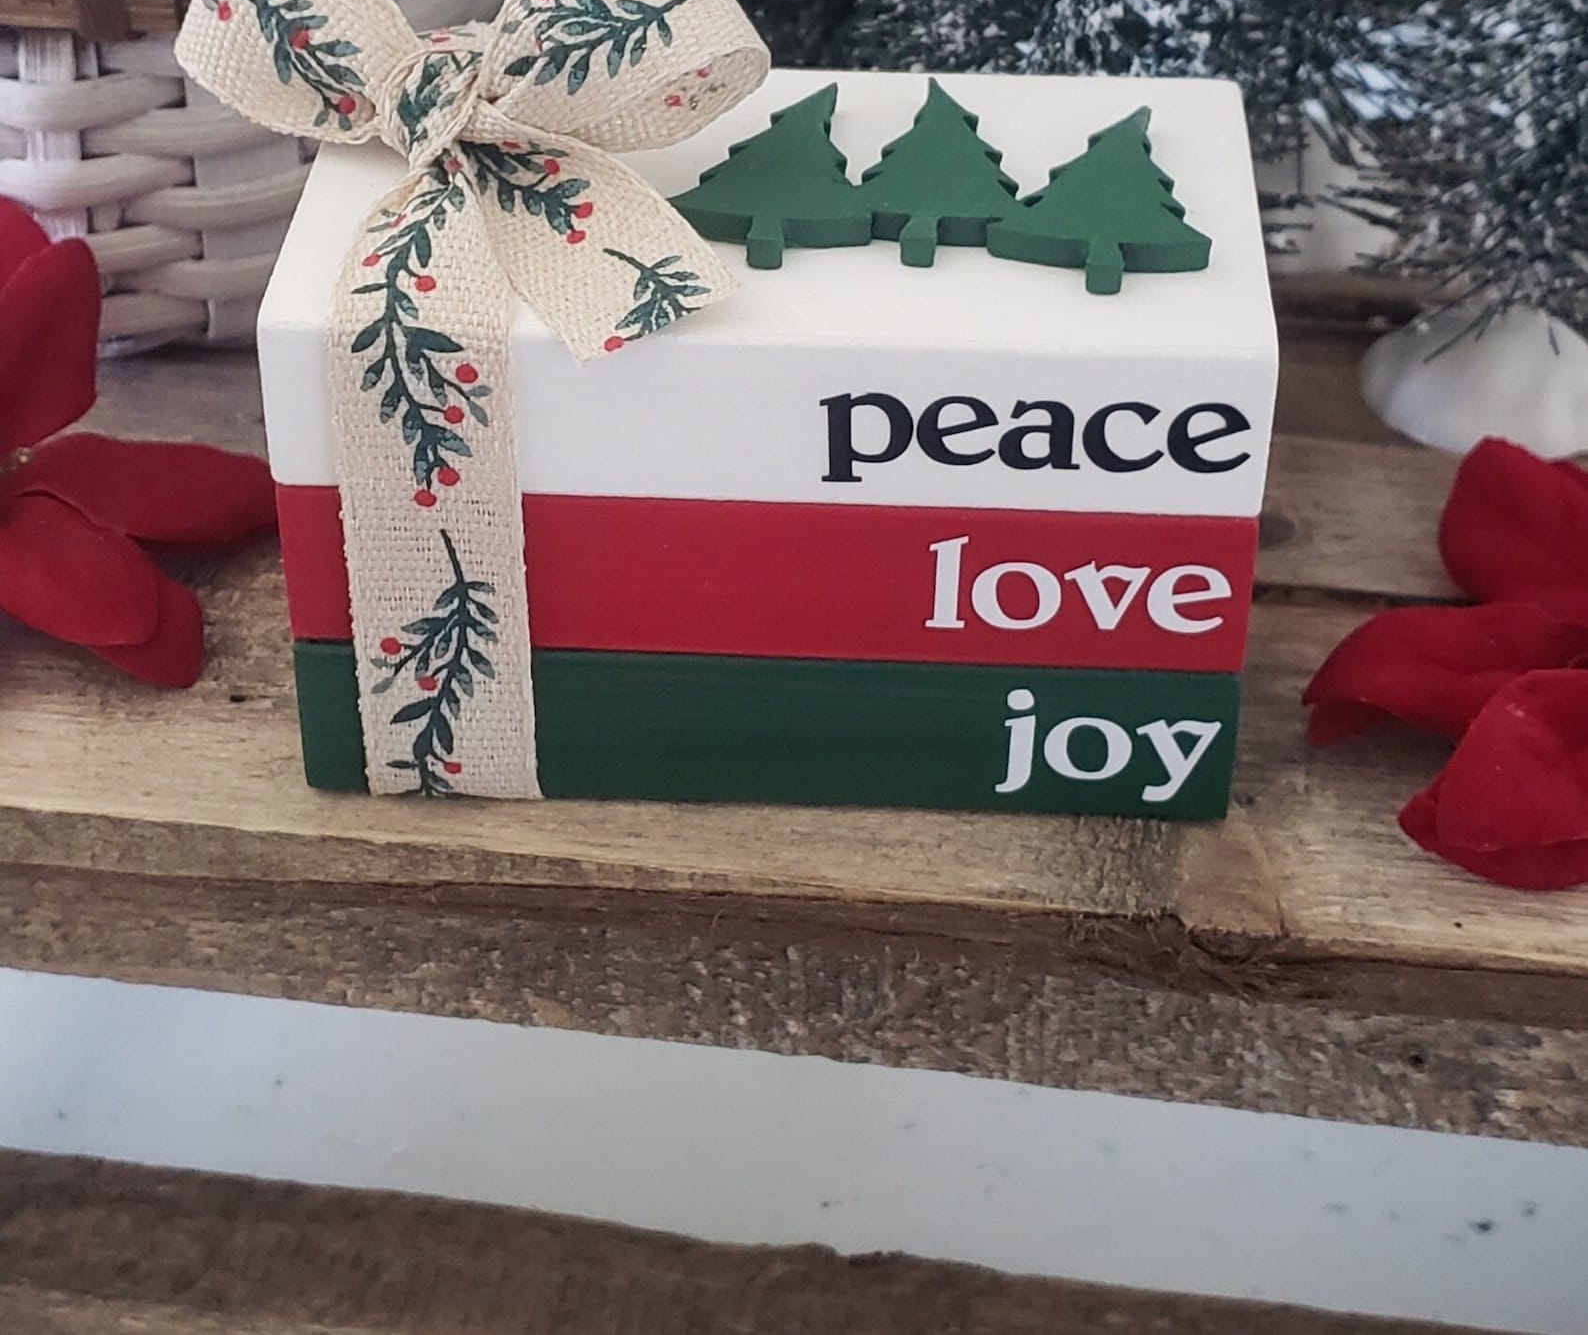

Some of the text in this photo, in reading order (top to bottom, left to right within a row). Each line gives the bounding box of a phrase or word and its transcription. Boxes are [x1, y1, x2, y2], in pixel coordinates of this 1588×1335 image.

[819, 392, 1252, 483] peace
[924, 535, 1232, 634] love
[995, 687, 1222, 803] joy
